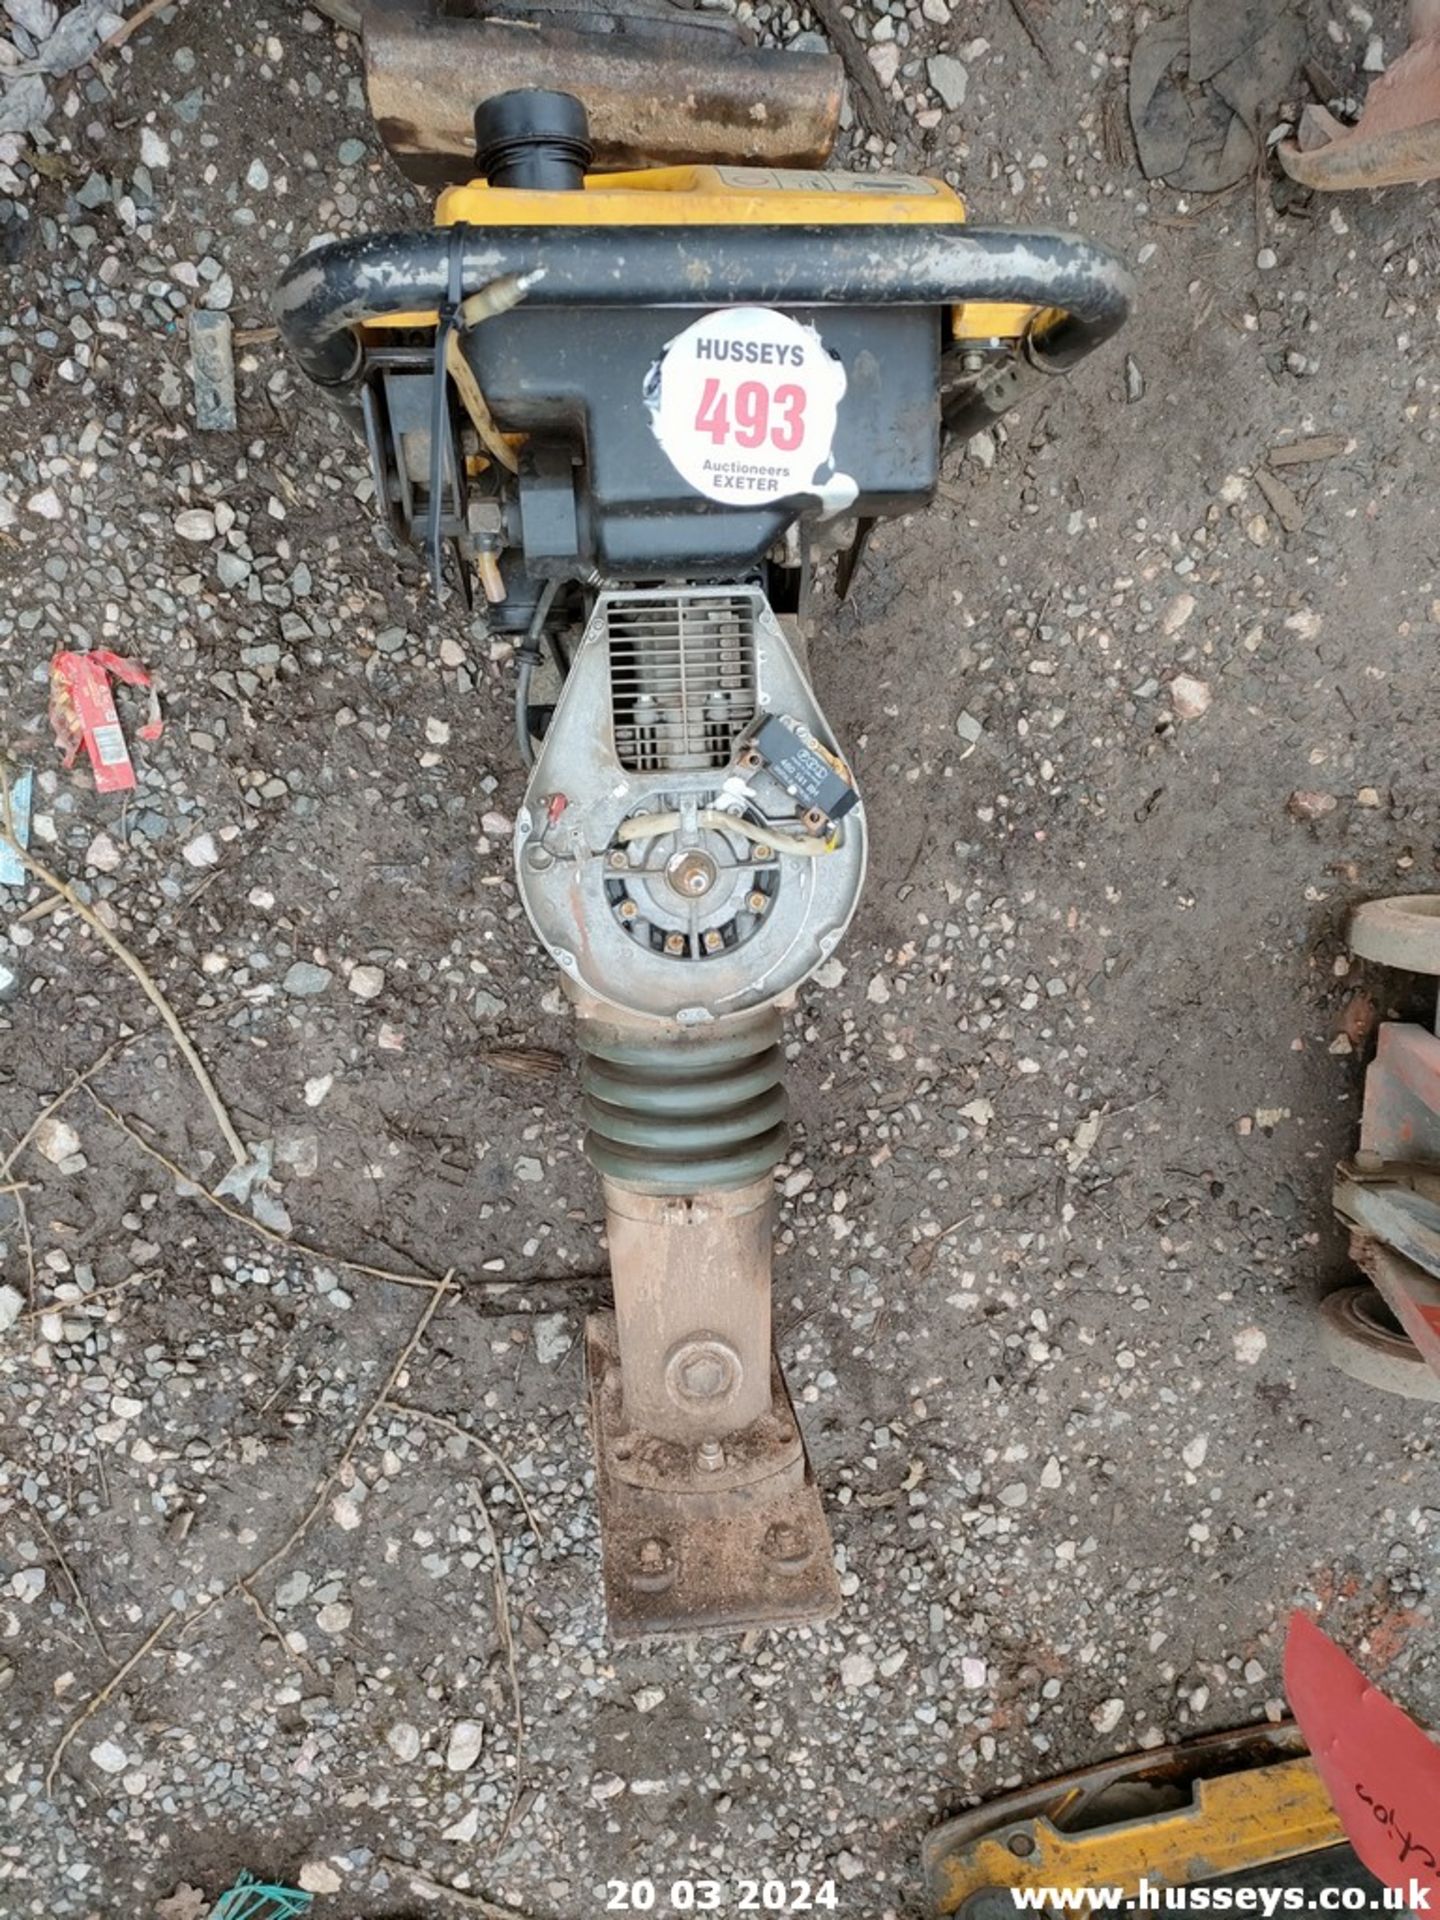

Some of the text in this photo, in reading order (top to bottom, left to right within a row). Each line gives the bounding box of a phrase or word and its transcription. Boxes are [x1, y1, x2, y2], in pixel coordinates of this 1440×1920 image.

[696, 338, 805, 367] HUSSEYS
[694, 378, 807, 452] 493
[702, 459, 790, 477] Auctioneers
[712, 474, 779, 491] EXETER
